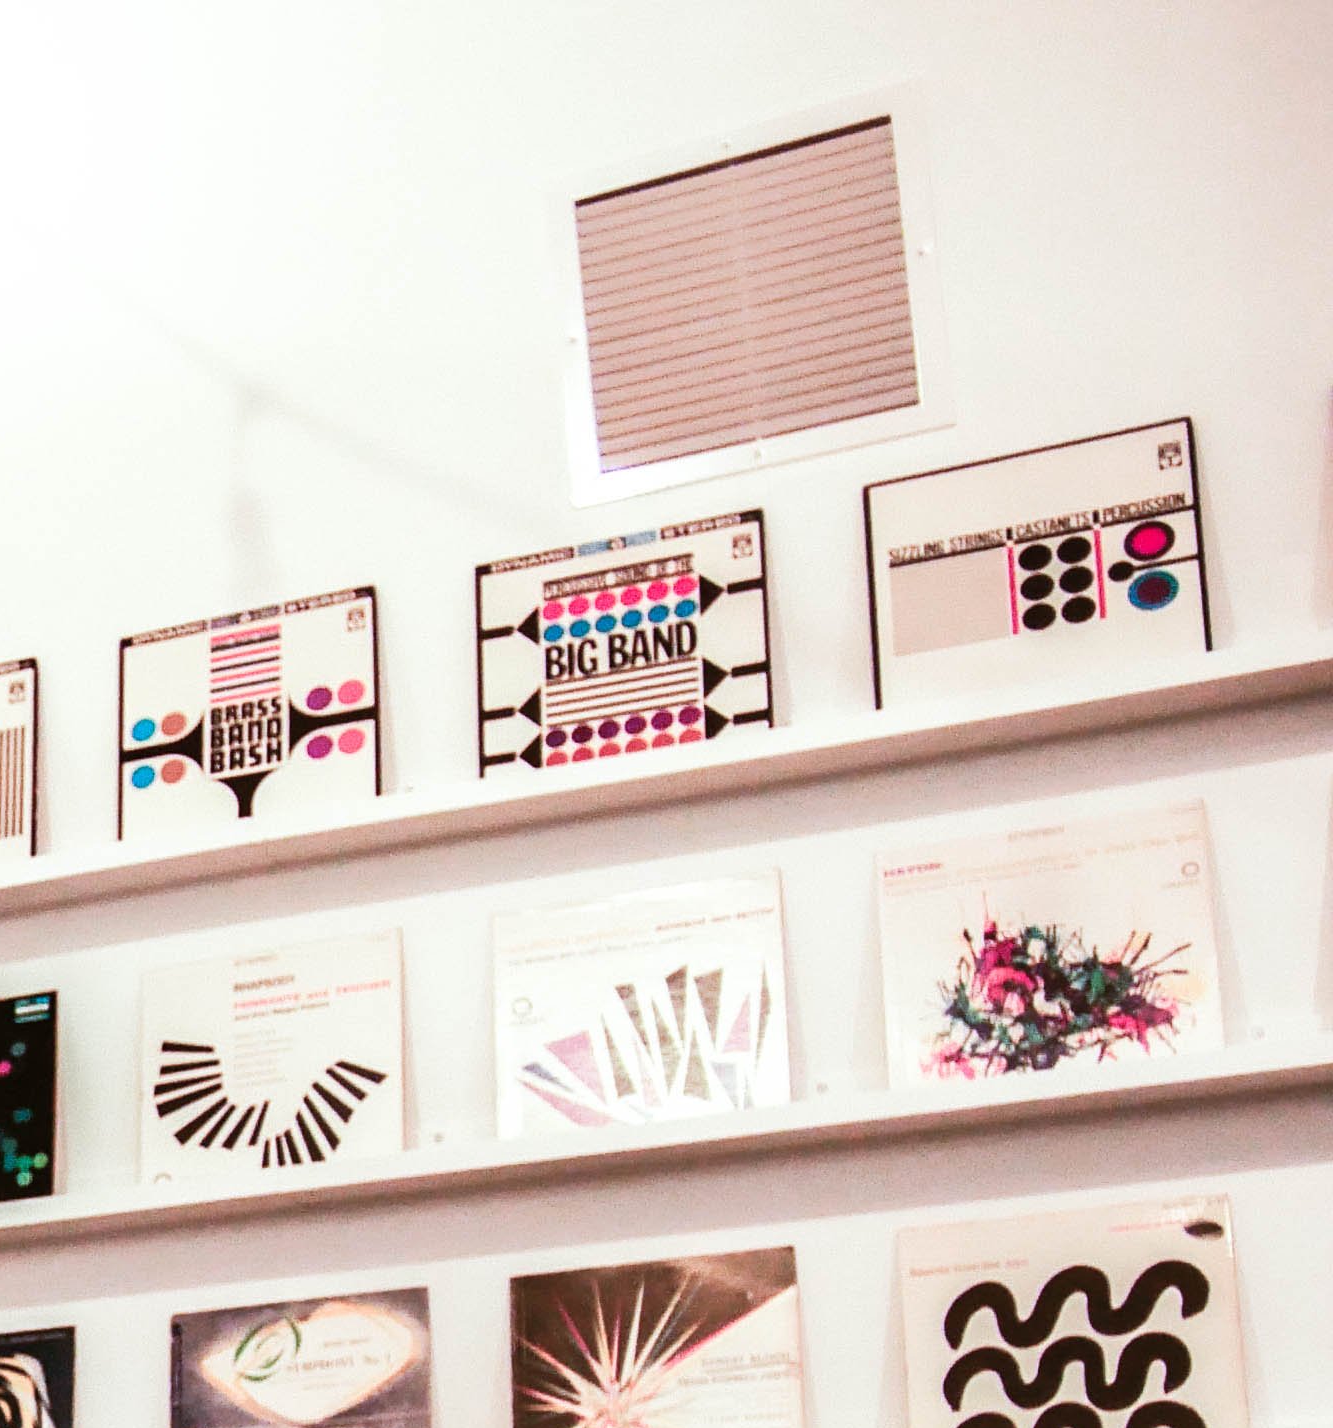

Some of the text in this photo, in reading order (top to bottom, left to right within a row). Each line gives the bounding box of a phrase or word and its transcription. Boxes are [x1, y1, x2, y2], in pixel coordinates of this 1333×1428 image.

[545, 621, 697, 680] BIG BAND
[209, 697, 282, 727] BRASS
[209, 717, 282, 749] BAND
[209, 740, 283, 774] BASH
